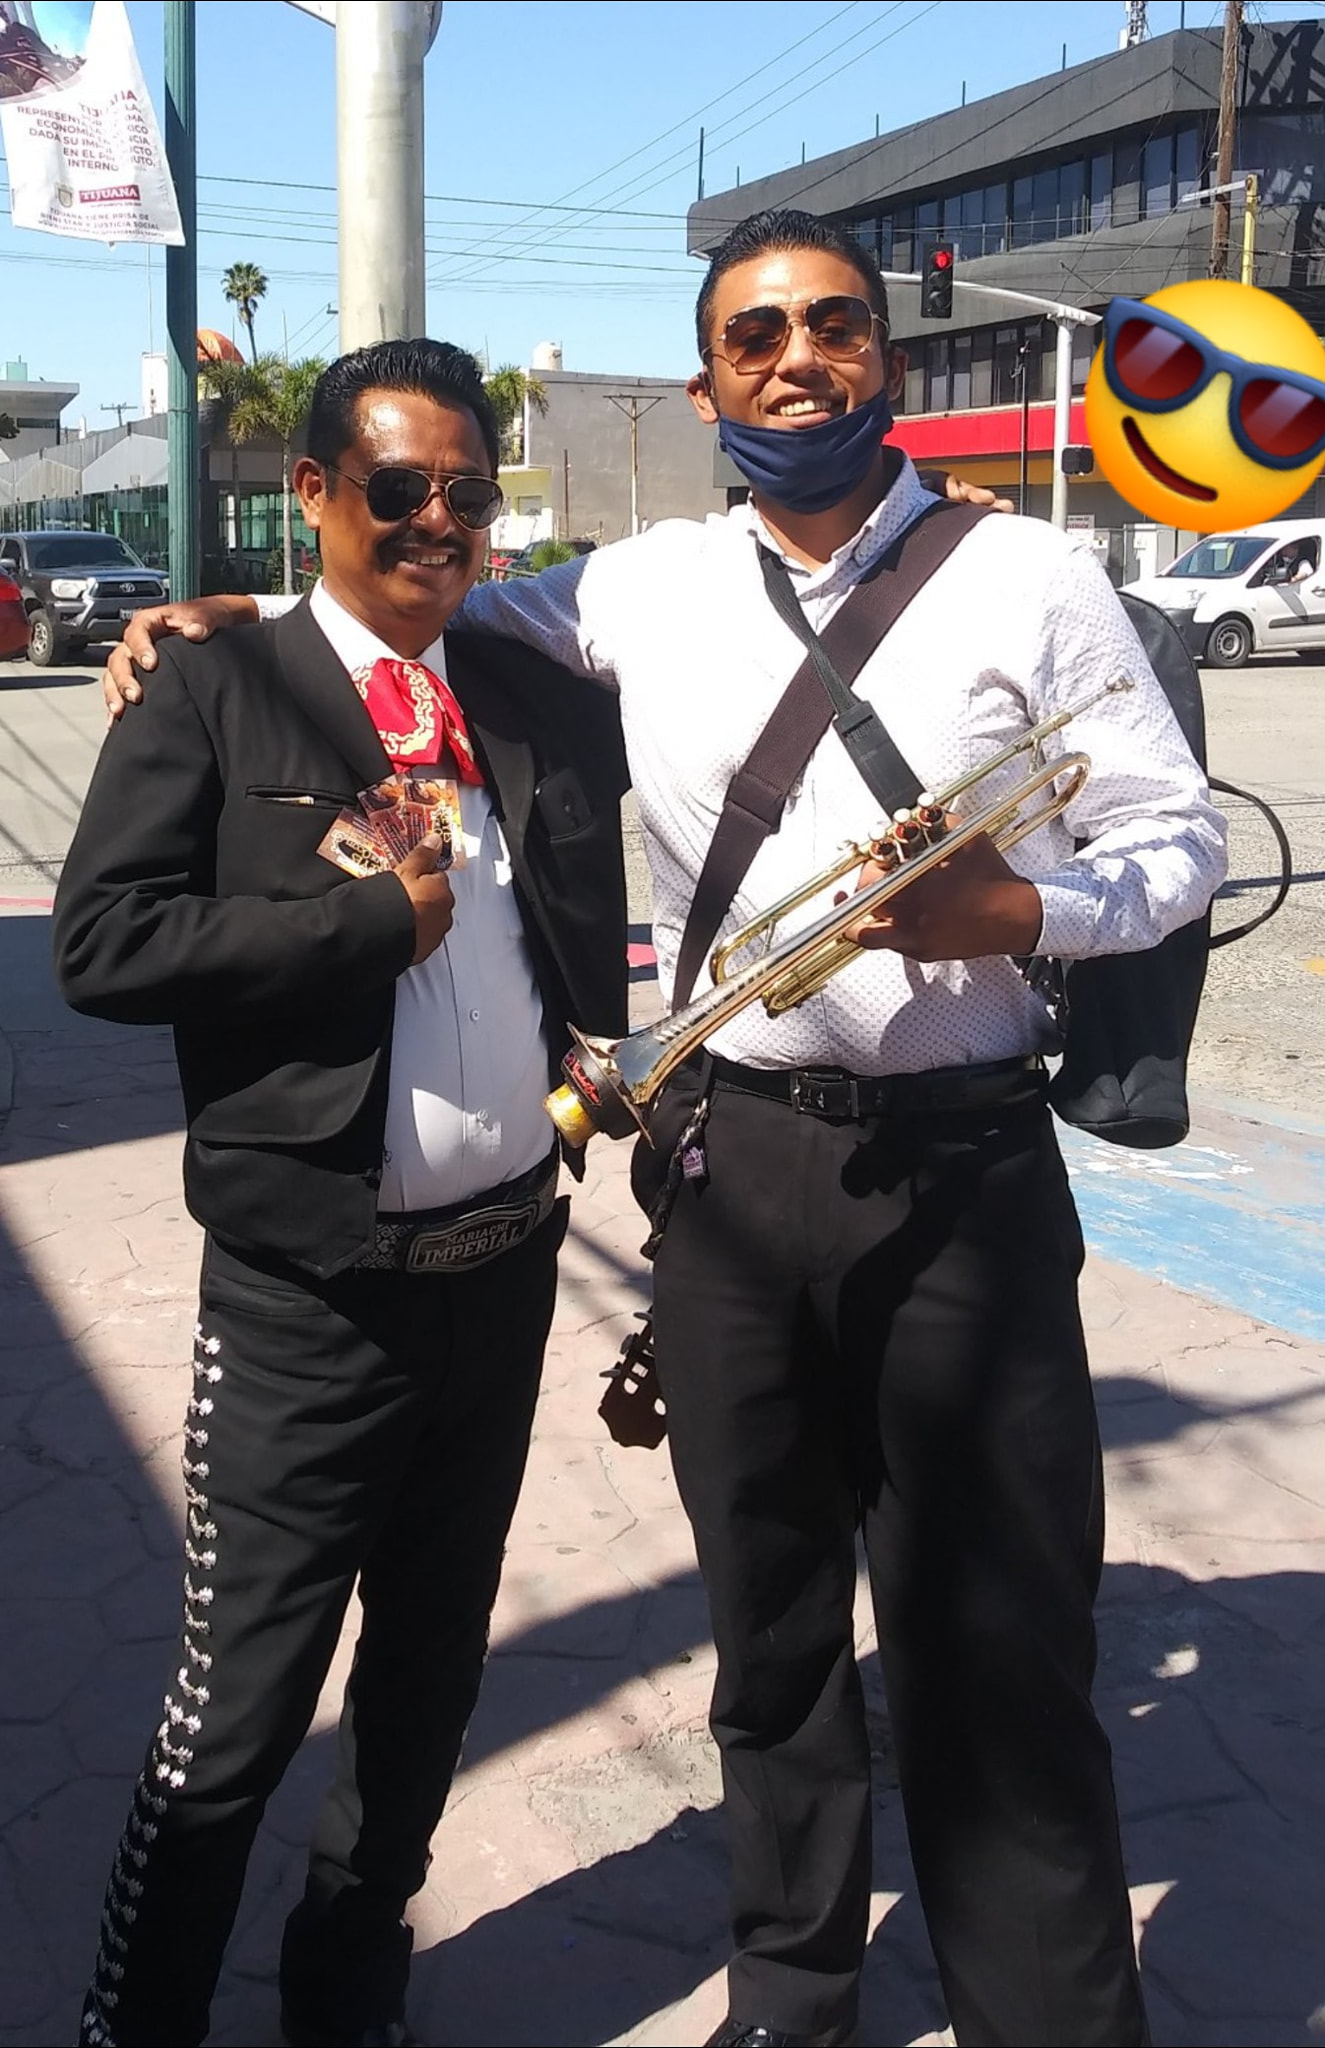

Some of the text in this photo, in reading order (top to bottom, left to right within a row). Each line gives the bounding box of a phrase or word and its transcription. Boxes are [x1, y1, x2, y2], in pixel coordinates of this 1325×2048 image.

[63, 136, 79, 147] SU
[63, 147, 79, 157] EN
[82, 149, 96, 159] EL
[81, 188, 138, 201] TIJUANA
[133, 221, 160, 231] SOCIAL
[445, 1220, 510, 1246] MARIACHI
[423, 1225, 522, 1266] IMPERIAL
